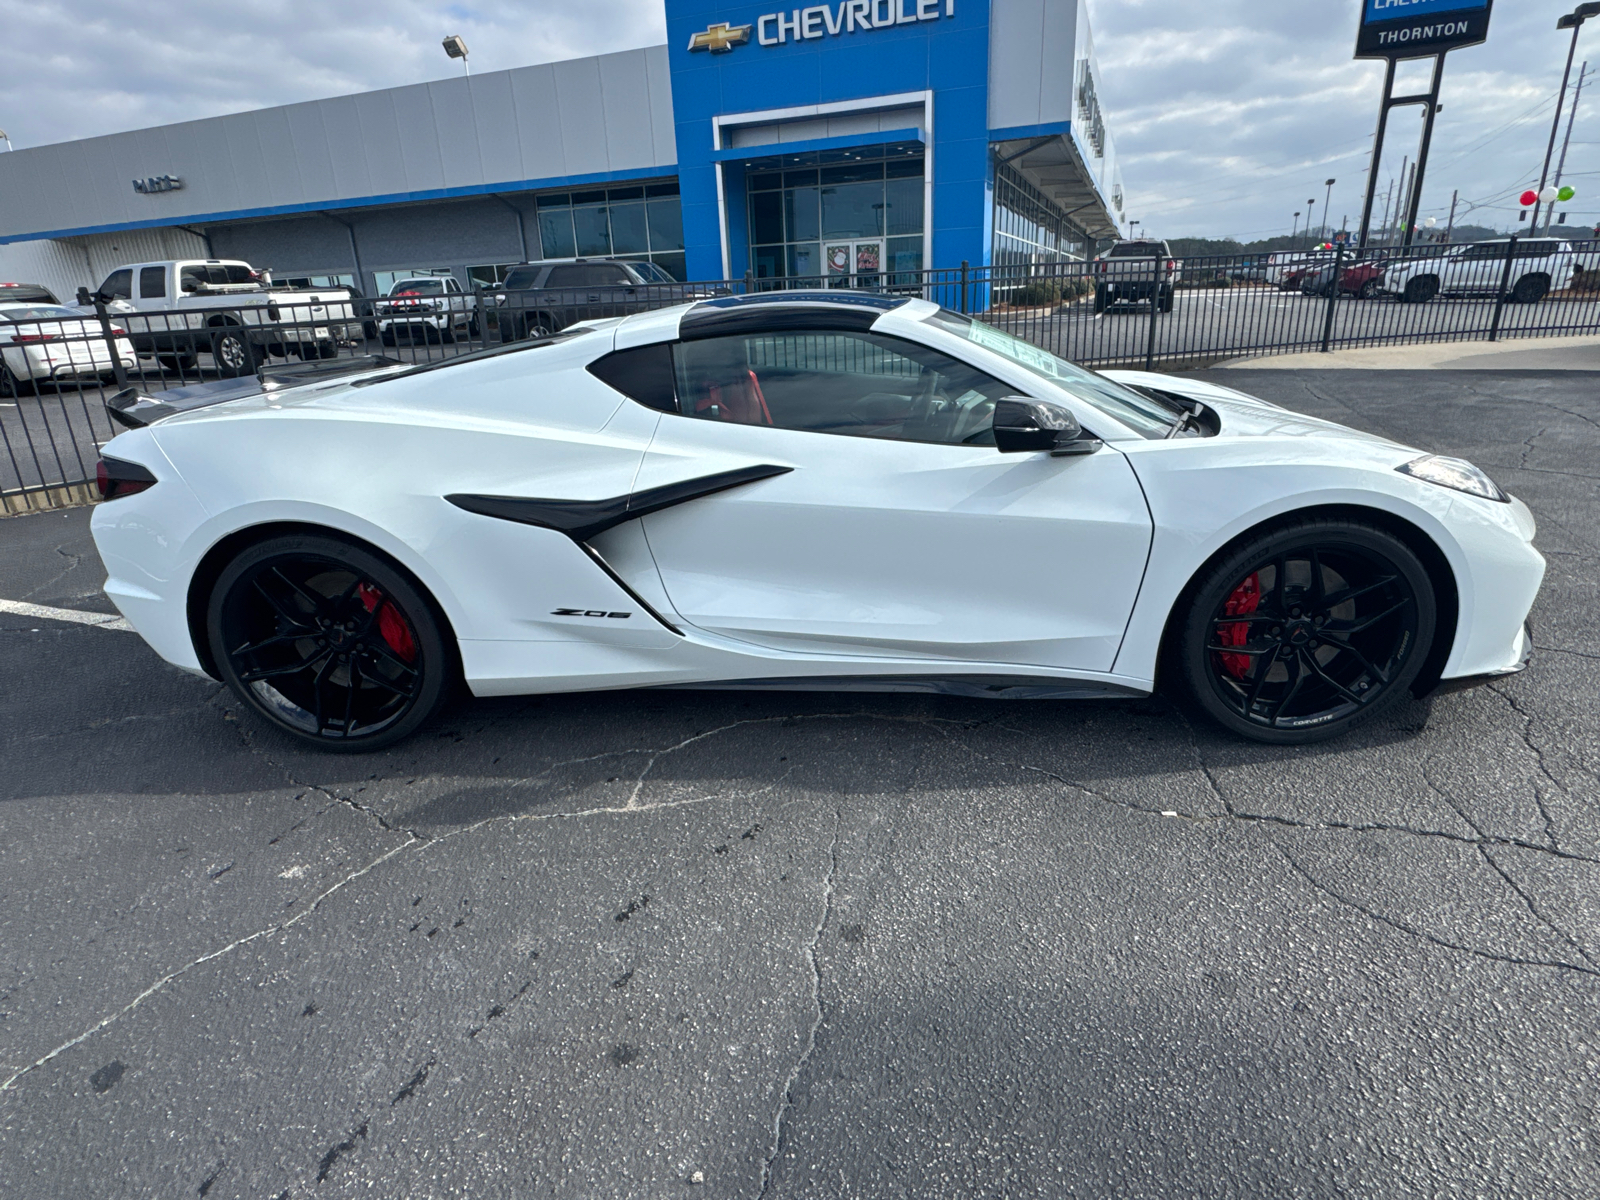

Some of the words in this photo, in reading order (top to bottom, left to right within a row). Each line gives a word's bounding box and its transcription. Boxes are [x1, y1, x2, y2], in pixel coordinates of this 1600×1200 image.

[1378, 20, 1469, 44] THORNTON
[549, 607, 633, 619] Z06
[1292, 714, 1333, 726] CORVETTE
